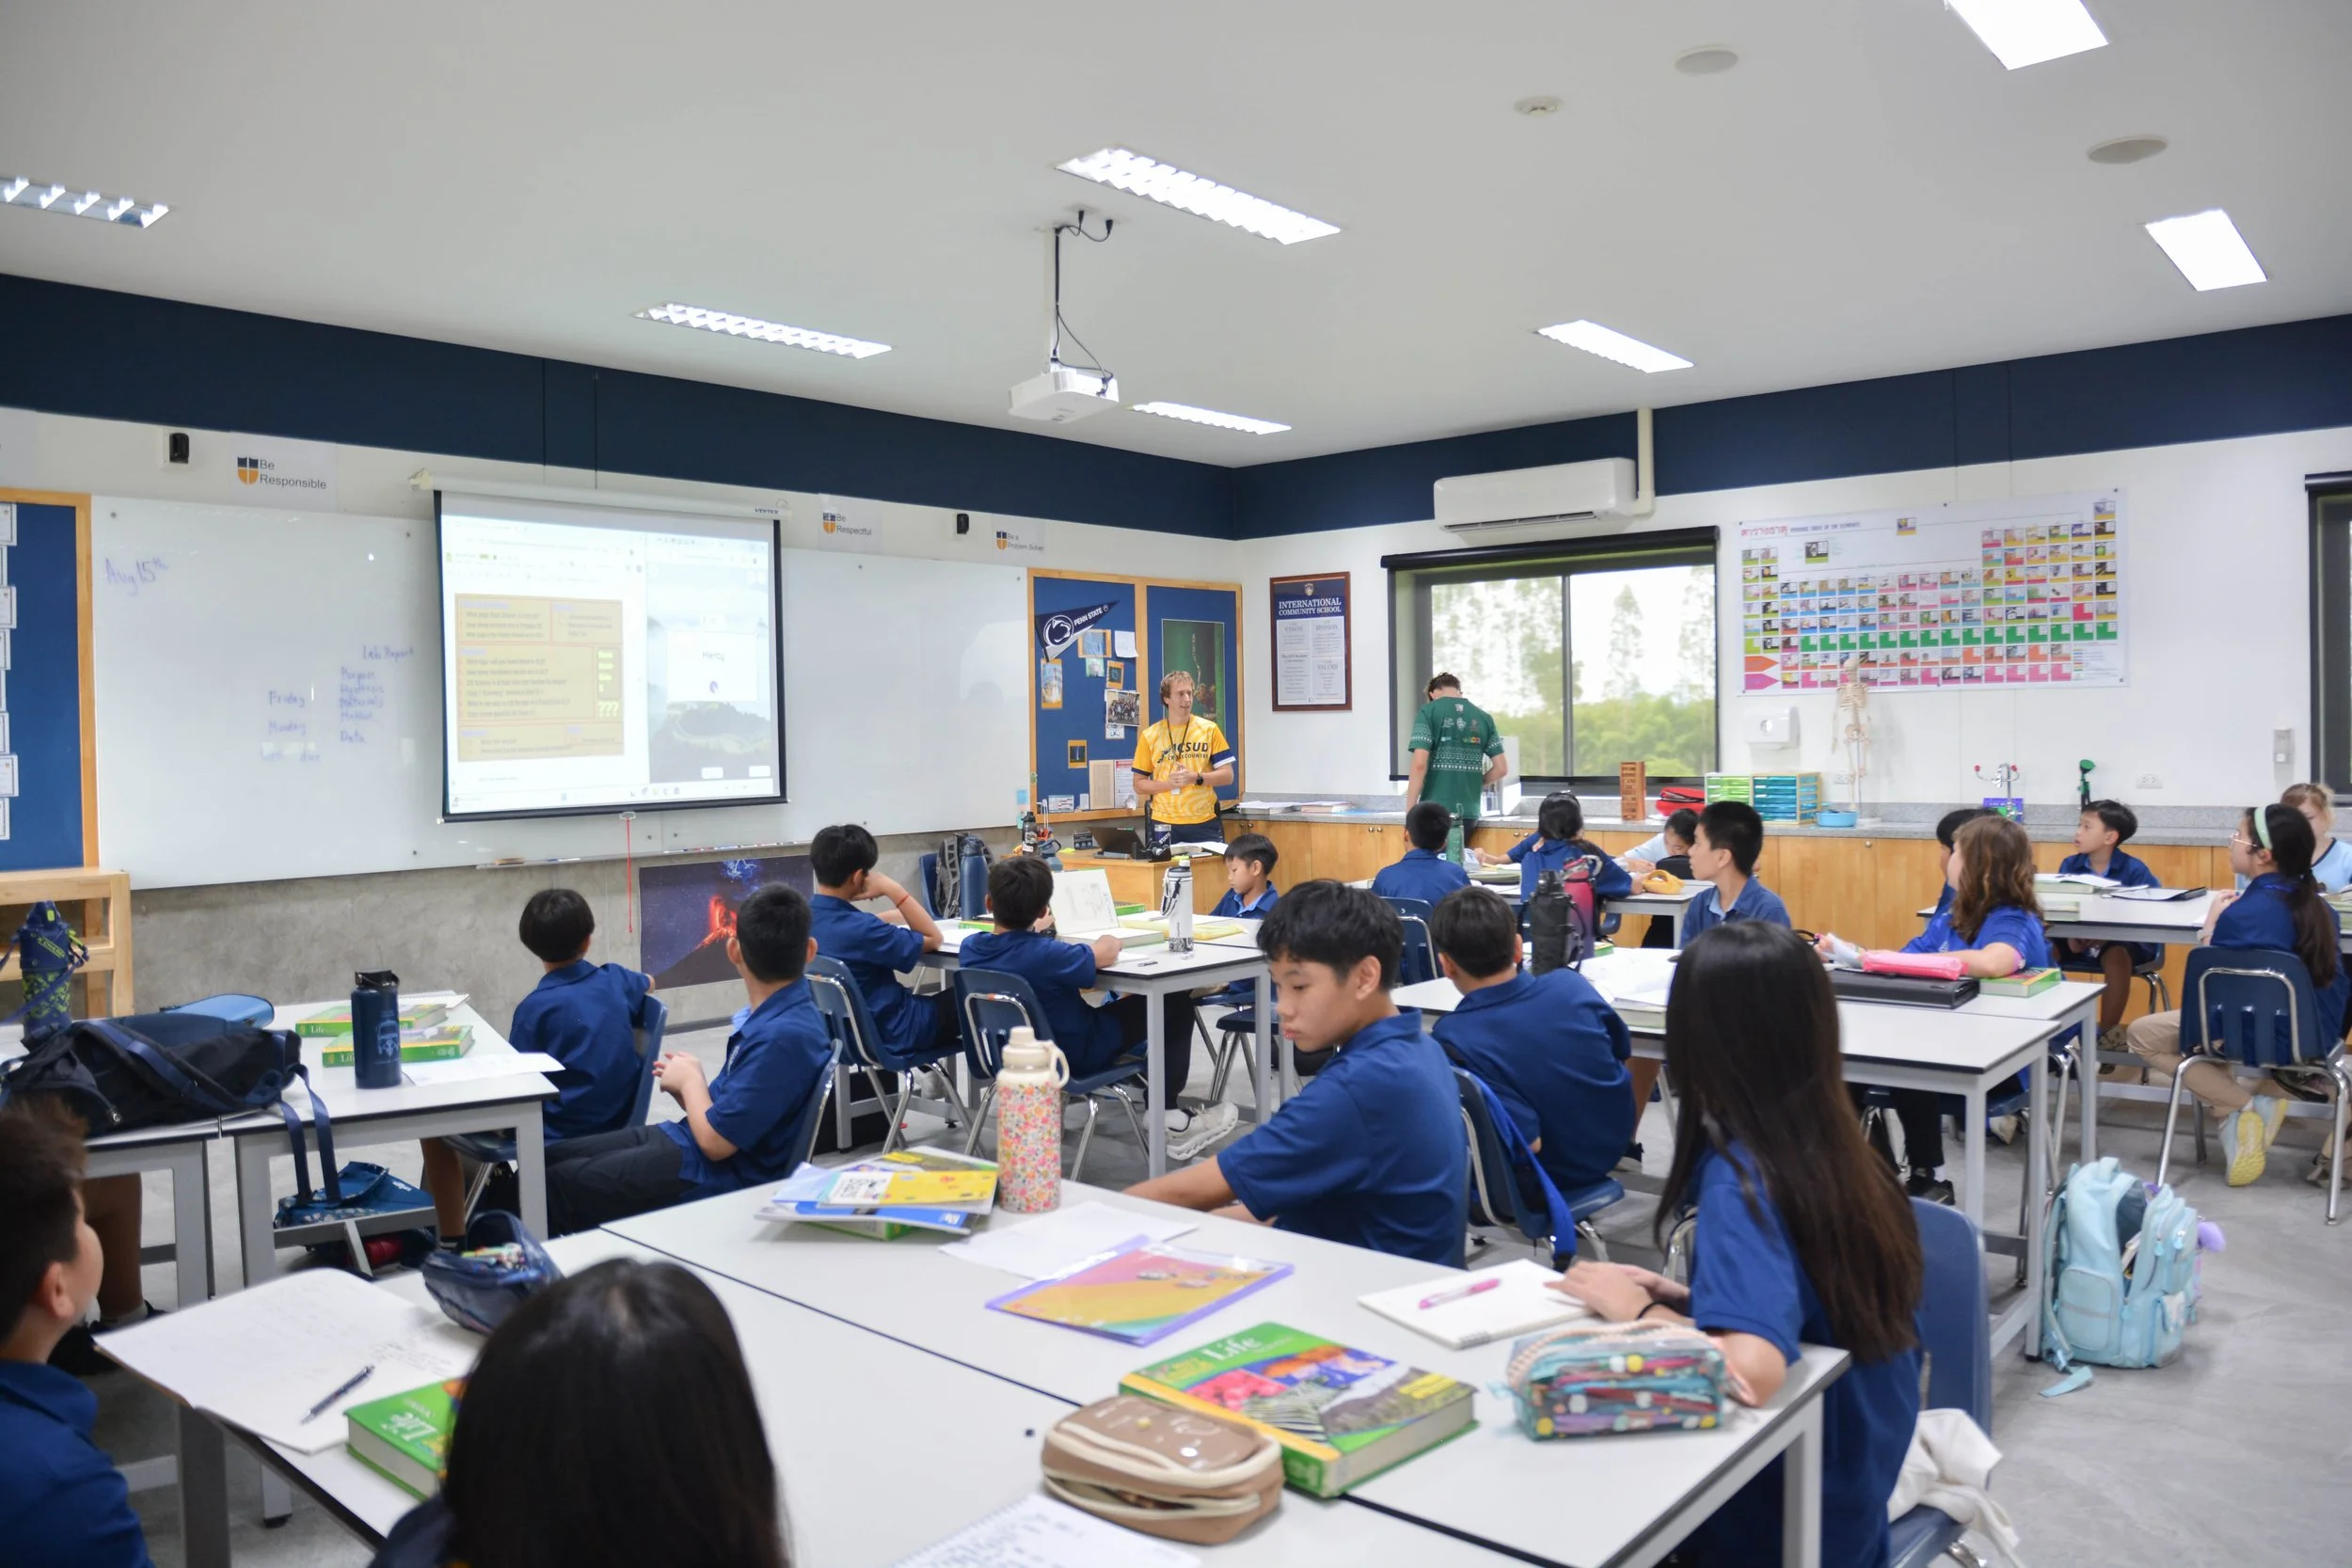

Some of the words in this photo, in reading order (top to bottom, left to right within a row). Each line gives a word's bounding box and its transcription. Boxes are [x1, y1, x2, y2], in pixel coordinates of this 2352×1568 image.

[260, 459, 275, 470] Be
[260, 474, 327, 489] Responsible
[837, 514, 846, 522] Be
[837, 525, 872, 536] Respectful
[1279, 597, 1342, 609] INTERNATIONAL
[1073, 614, 1089, 626] PENN
[1088, 607, 1104, 620] STATE
[1279, 608, 1315, 616] COMMUNITY
[1317, 606, 1342, 614] SCHOOL
[702, 651, 725, 662] Mercy
[341, 1053, 356, 1063] Lif
[1201, 1337, 1263, 1360] Life
